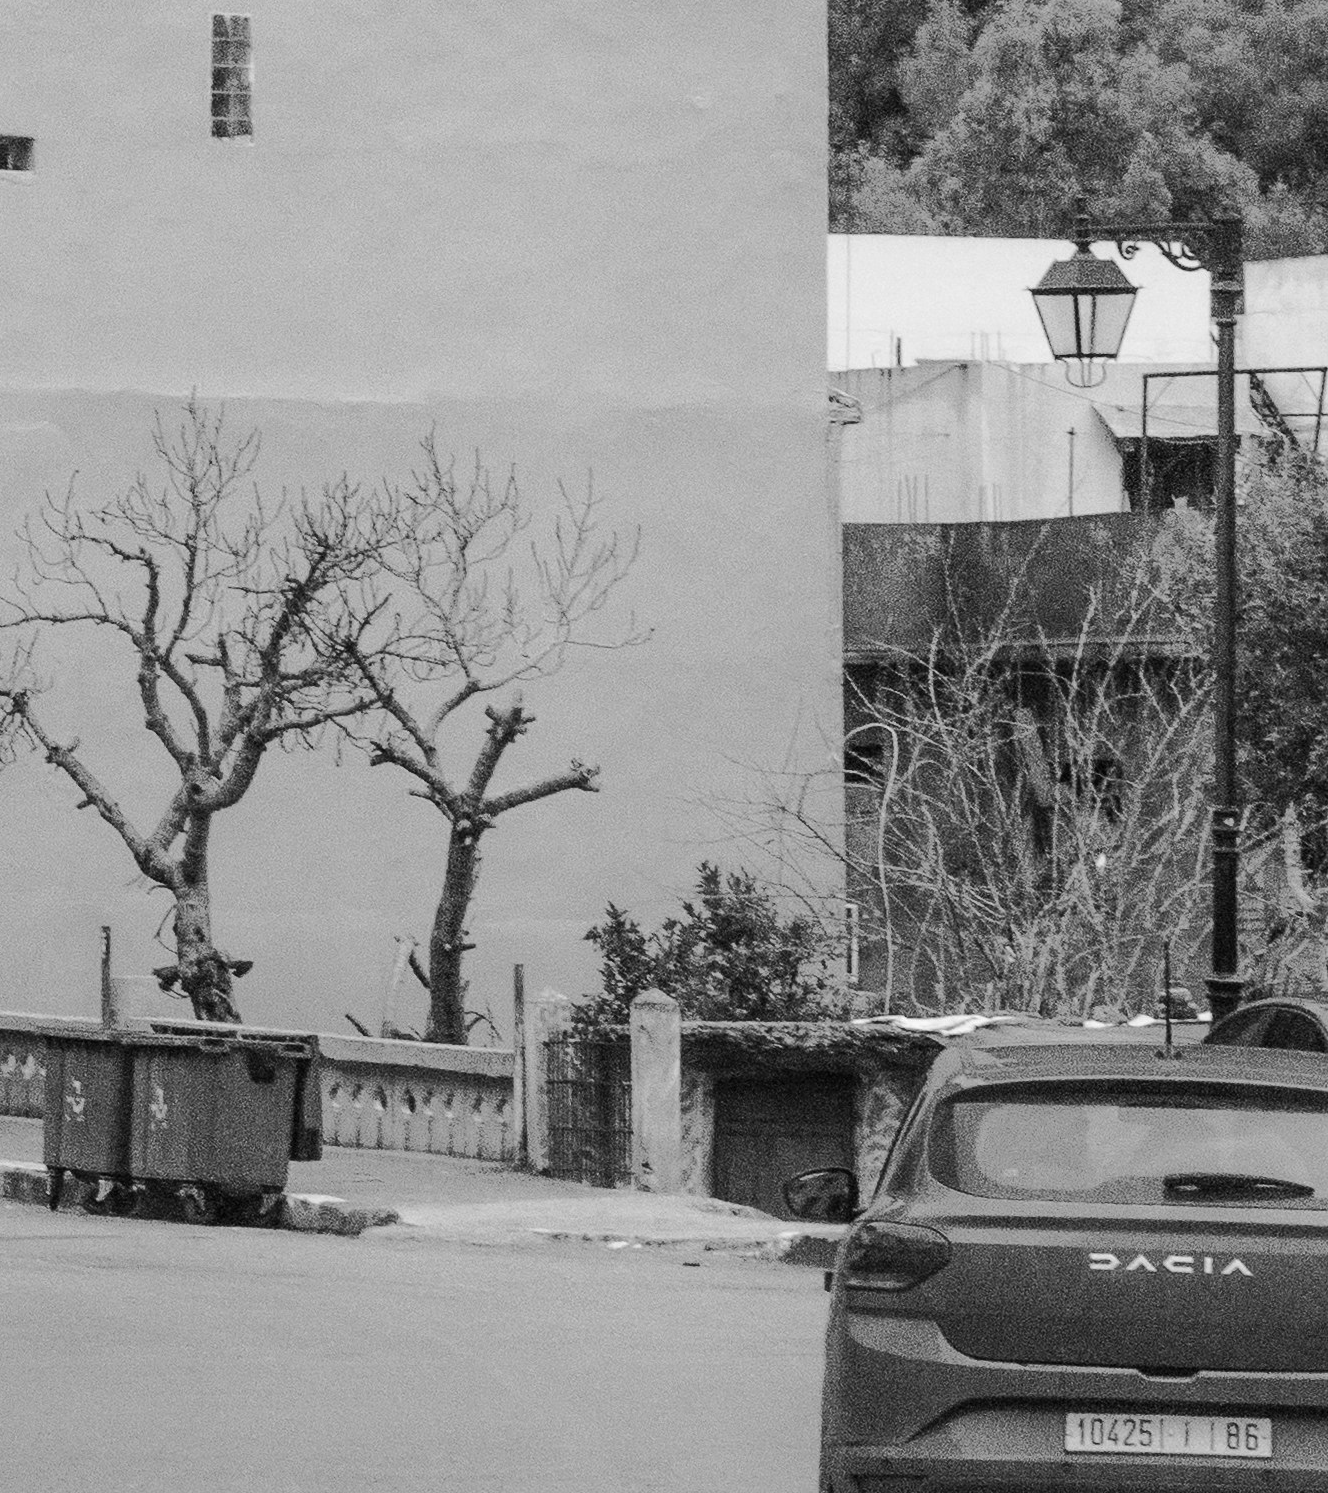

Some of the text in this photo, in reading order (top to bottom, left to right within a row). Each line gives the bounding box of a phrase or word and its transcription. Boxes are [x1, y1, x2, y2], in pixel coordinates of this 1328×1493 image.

[1087, 1252, 1254, 1277] DACIA
[1077, 1417, 1153, 1448] 10425
[1226, 1421, 1259, 1450] 86
